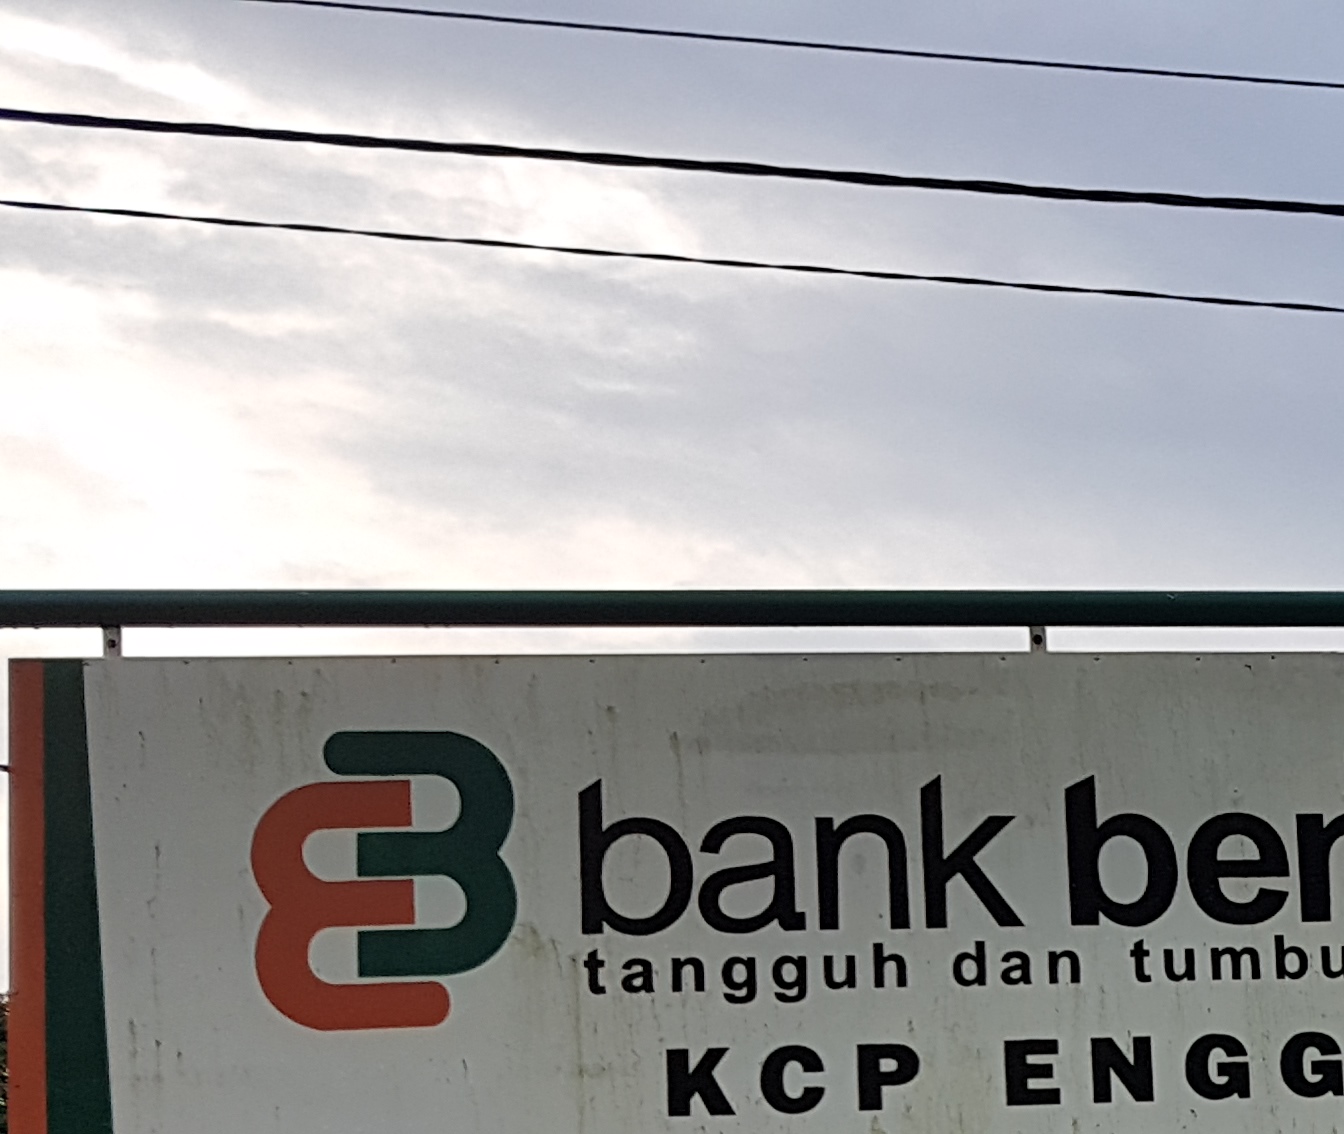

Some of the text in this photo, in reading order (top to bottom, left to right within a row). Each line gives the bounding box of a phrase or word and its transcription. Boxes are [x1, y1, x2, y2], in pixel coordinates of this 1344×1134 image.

[577, 778, 1025, 937] bank
[583, 942, 909, 1006] tangguh
[952, 940, 1081, 987] dan
[665, 1043, 920, 1117] KCP
